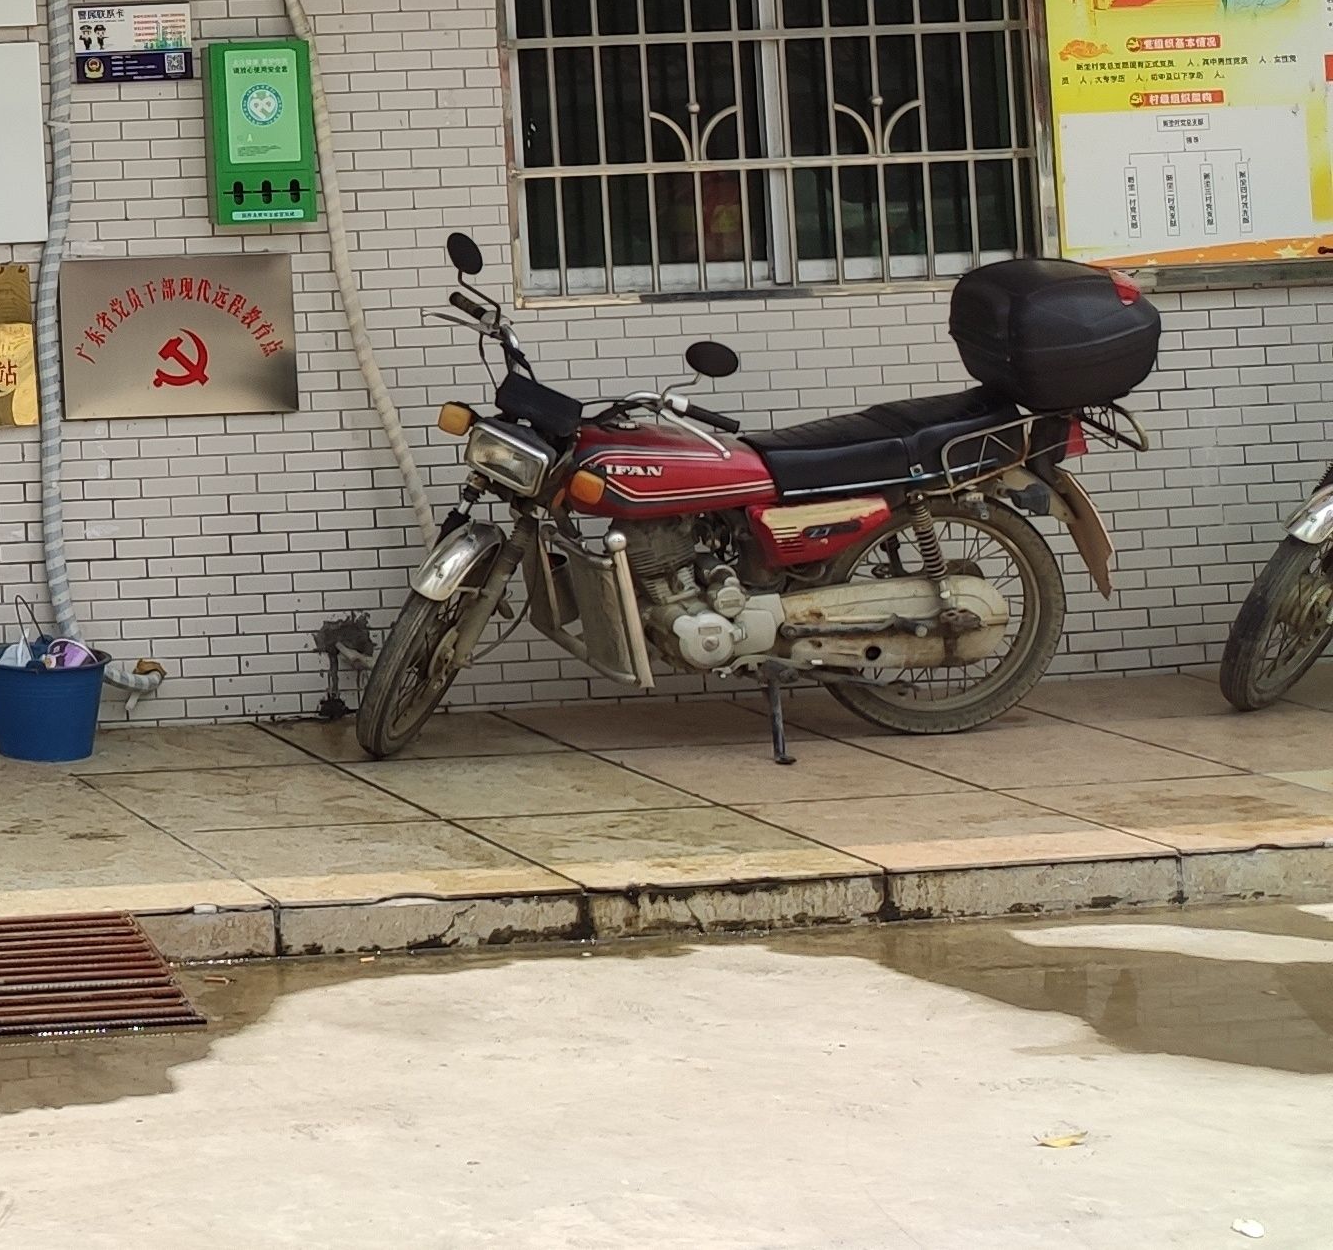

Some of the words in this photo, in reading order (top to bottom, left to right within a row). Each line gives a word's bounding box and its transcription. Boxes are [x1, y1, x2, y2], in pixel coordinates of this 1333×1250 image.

[74, 276, 285, 365] 广东省党员干部现代远程教育点
[605, 463, 664, 478] IFAN
